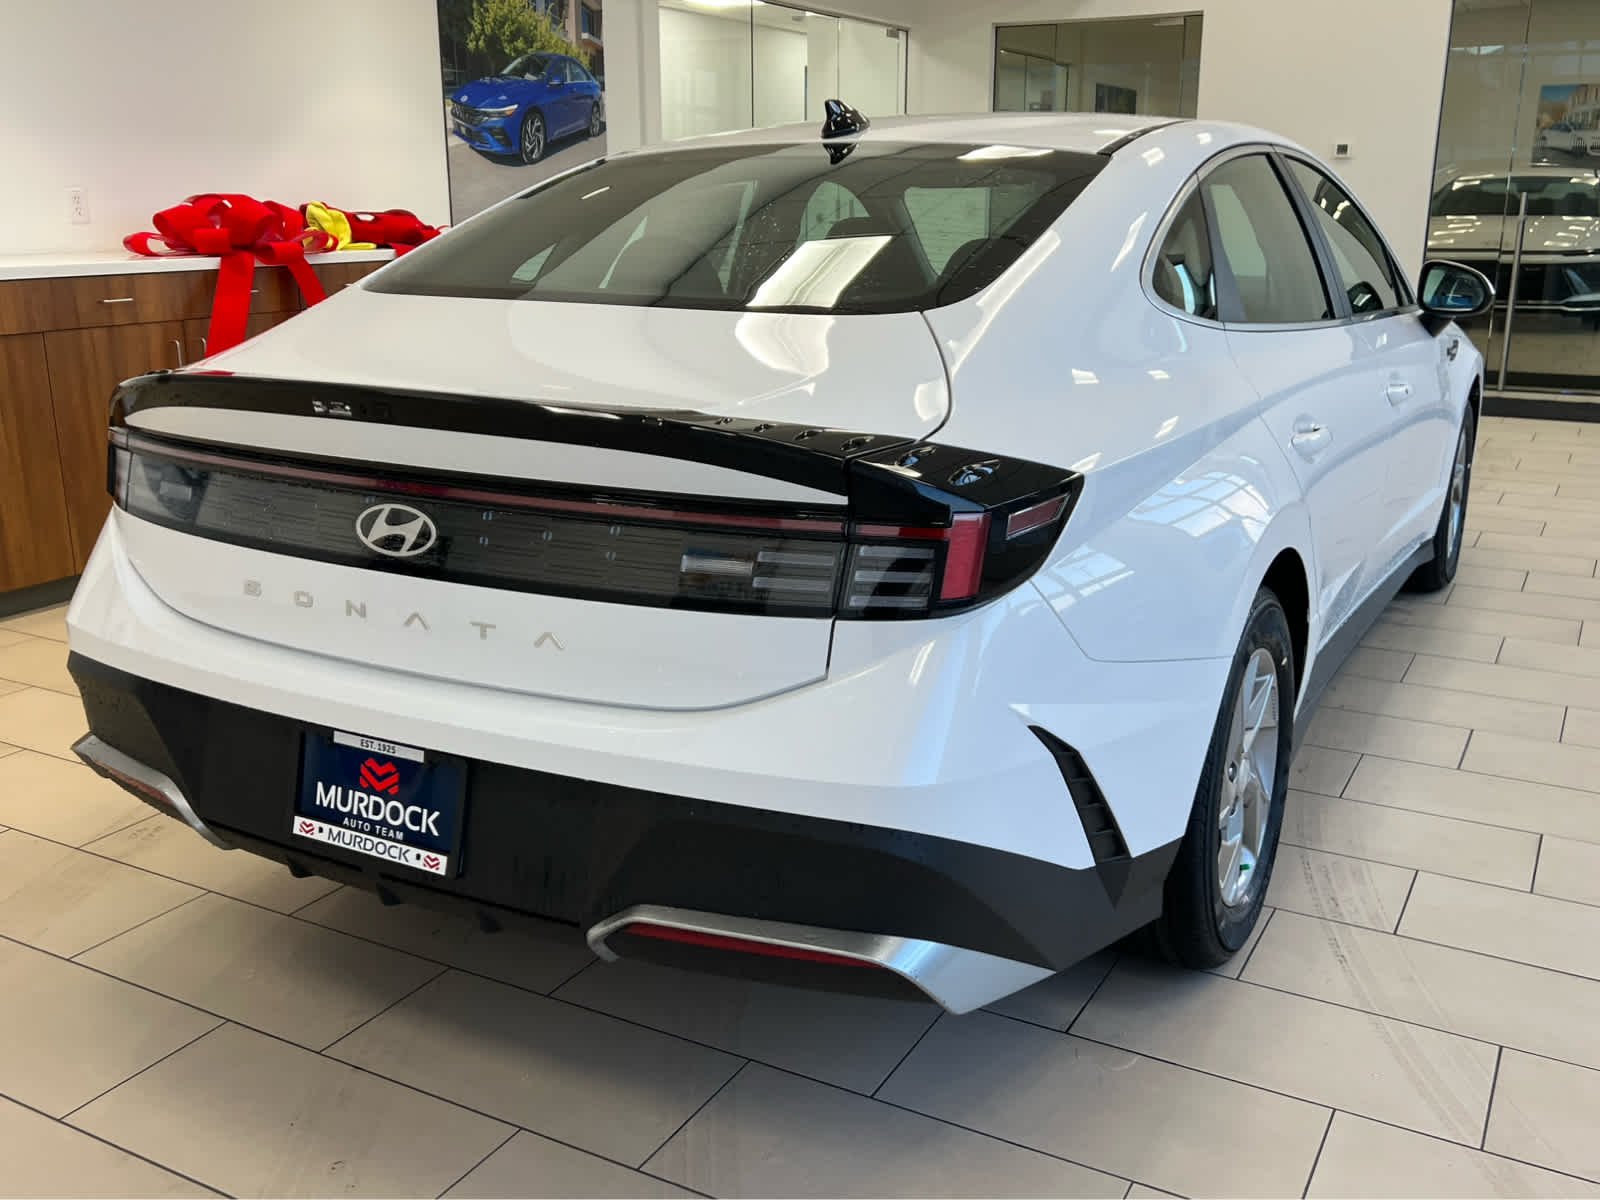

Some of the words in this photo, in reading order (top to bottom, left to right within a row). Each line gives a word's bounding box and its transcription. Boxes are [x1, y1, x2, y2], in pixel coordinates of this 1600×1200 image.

[244, 579, 565, 650] SONATA
[316, 781, 441, 837] MURDOCK
[343, 817, 371, 832] AUTO
[375, 825, 404, 841] TEAM
[327, 828, 410, 863] MURDOCK
